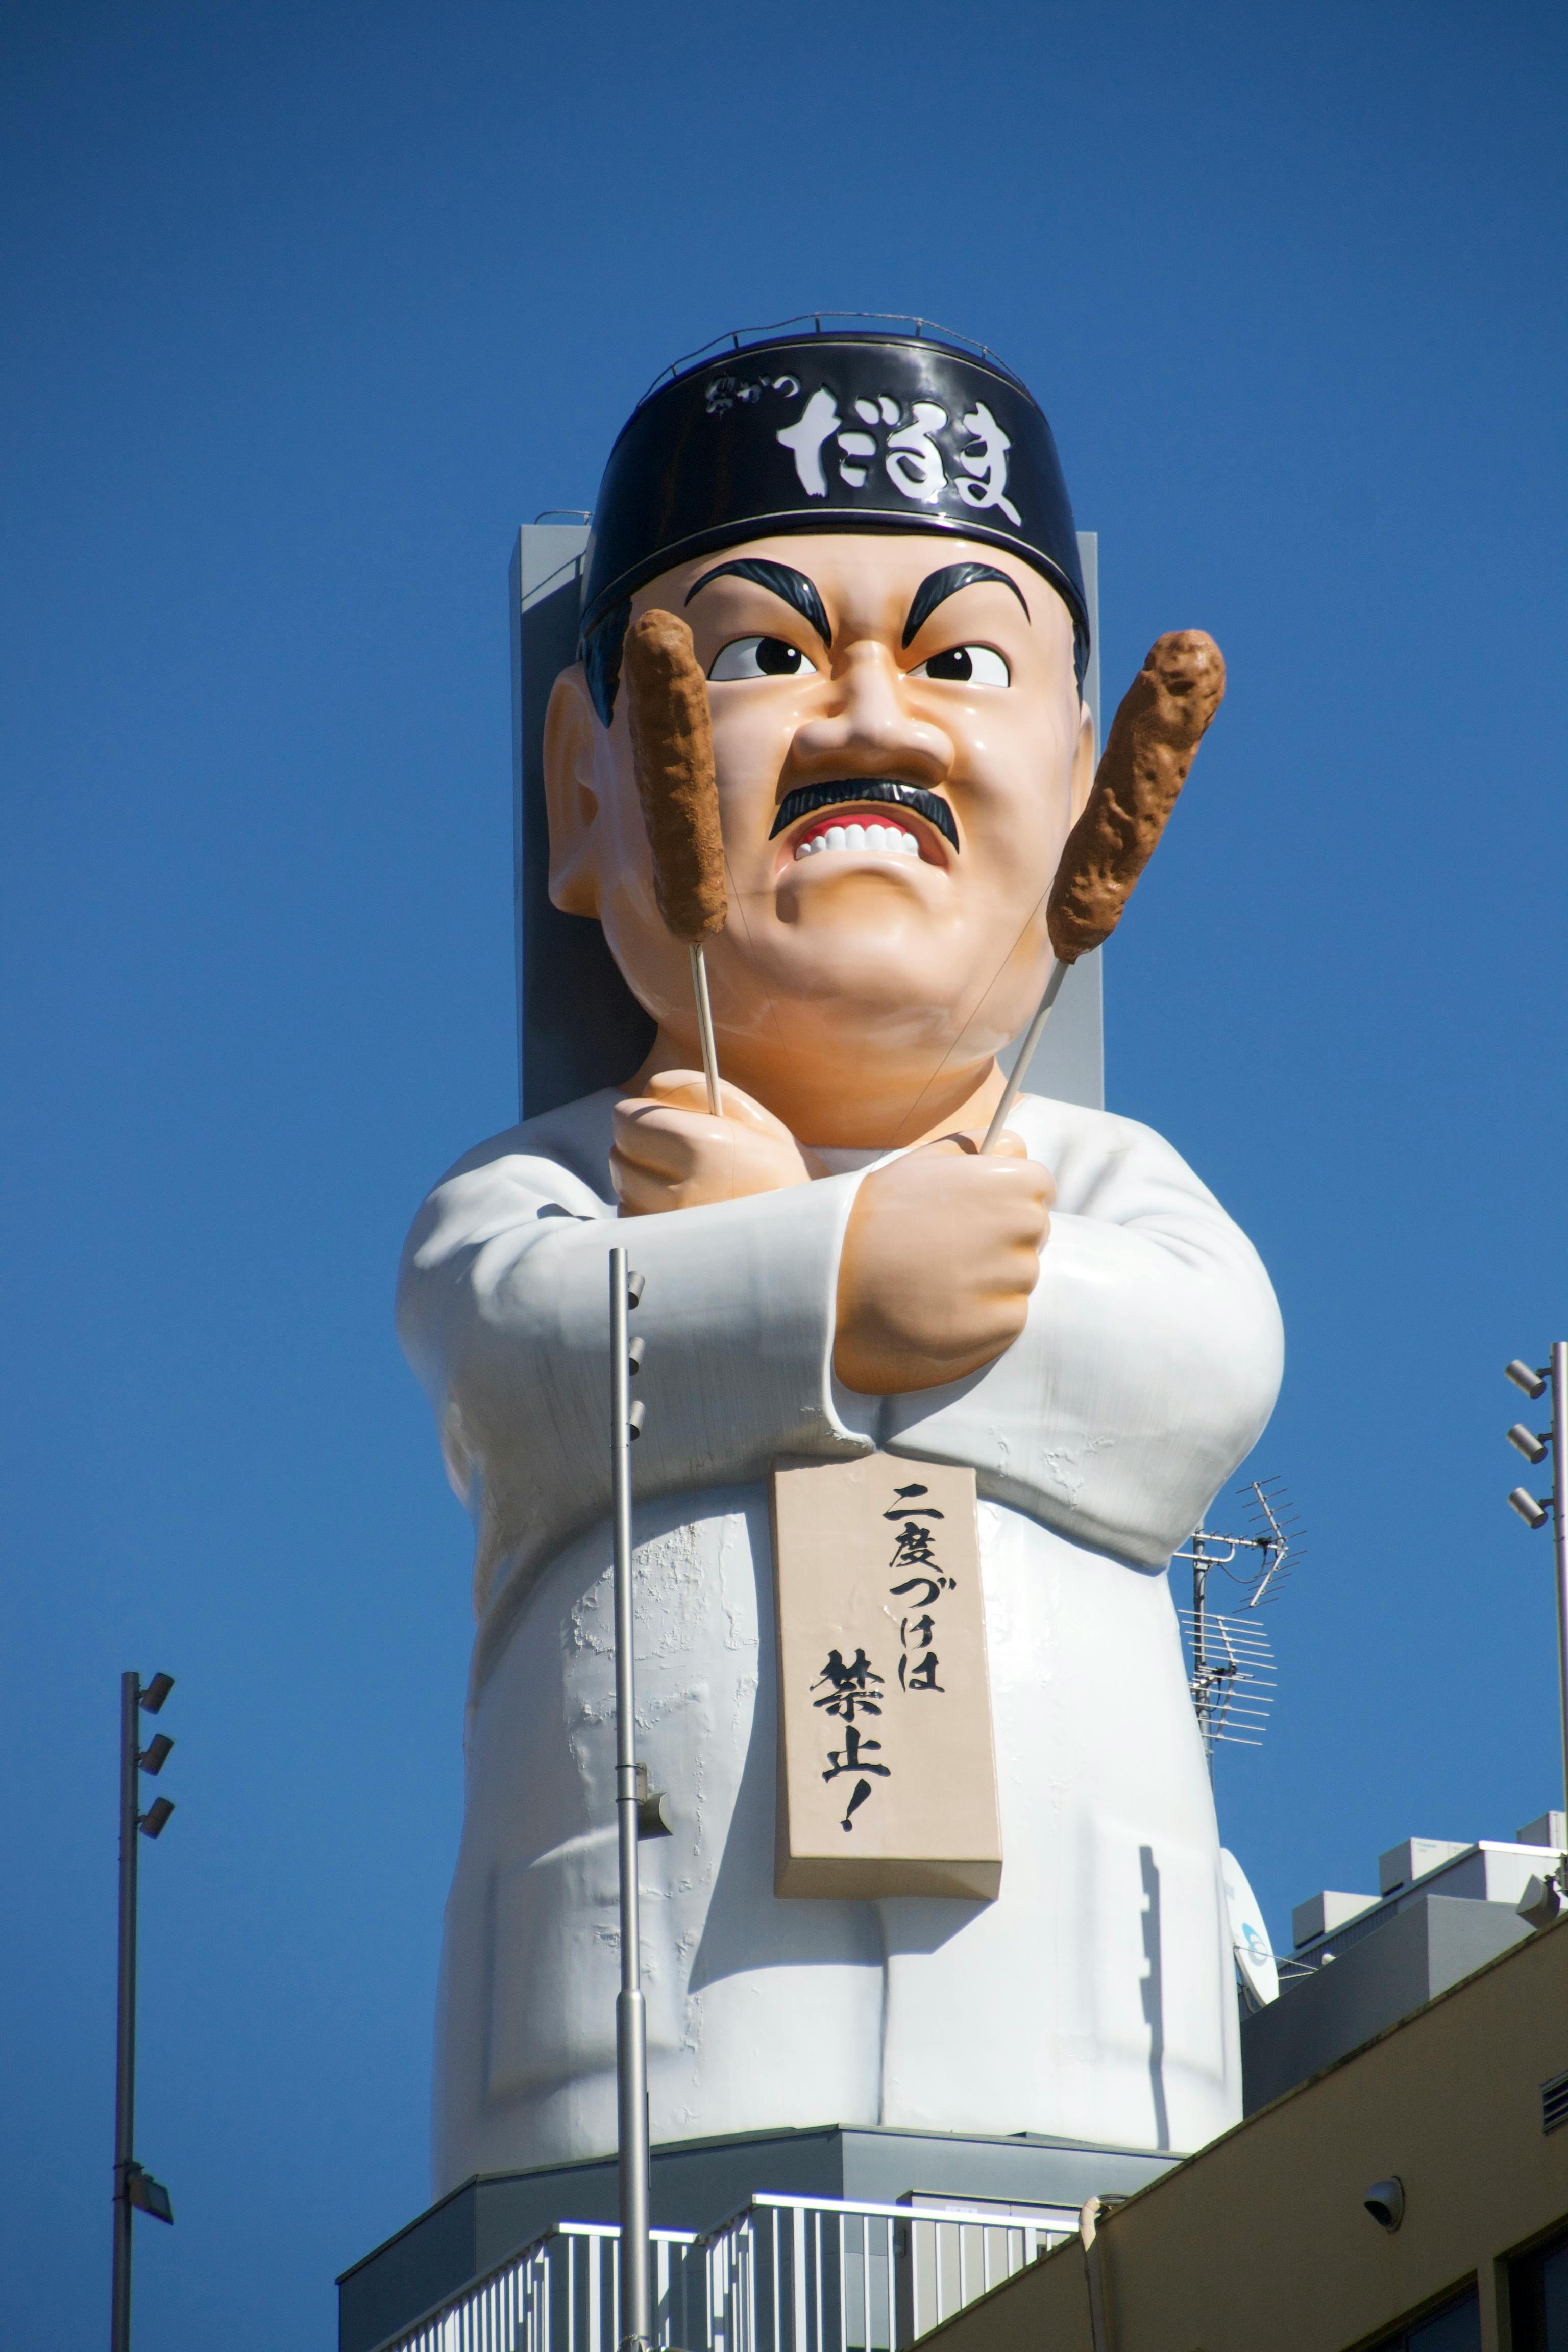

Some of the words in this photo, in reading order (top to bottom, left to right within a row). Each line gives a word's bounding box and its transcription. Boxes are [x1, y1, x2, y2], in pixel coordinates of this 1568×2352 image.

[776, 385, 1021, 527] だるま
[883, 1483, 957, 1693] 二度づけは
[810, 1648, 891, 1832] 禁止!
